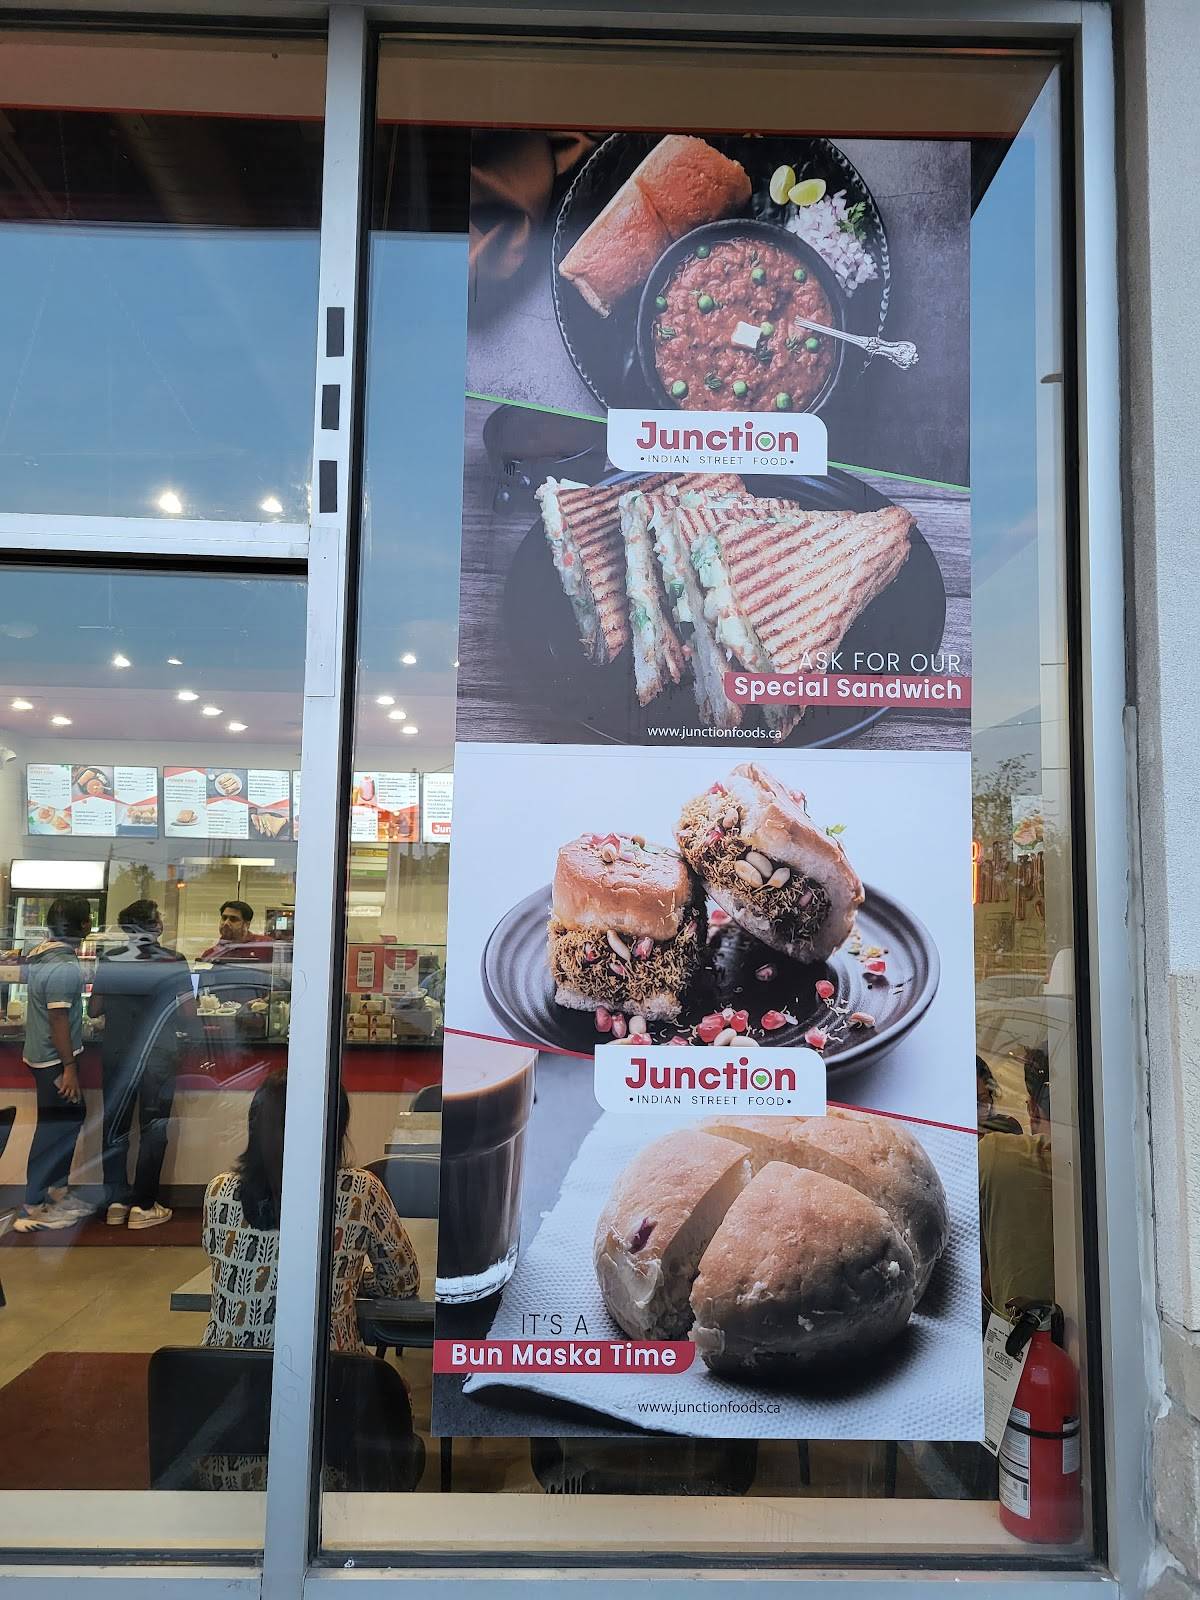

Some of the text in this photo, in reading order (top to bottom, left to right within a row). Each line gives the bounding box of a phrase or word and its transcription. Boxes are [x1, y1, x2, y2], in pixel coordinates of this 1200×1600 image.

[636, 421, 799, 453] Junction
[647, 454, 788, 466] INDIAN STREET FOOD
[799, 652, 961, 673] ASK FOR OUR
[734, 676, 962, 701] Special Sandwich
[647, 726, 782, 739] www.junctionfoods.ca
[625, 1056, 796, 1091] Junction
[636, 1094, 785, 1107] INDIAN STREET FOOD
[521, 1313, 589, 1335] IT'S A
[452, 1344, 677, 1367] Bun Maska Time
[637, 1401, 781, 1415] www.junctionfoods.ca
